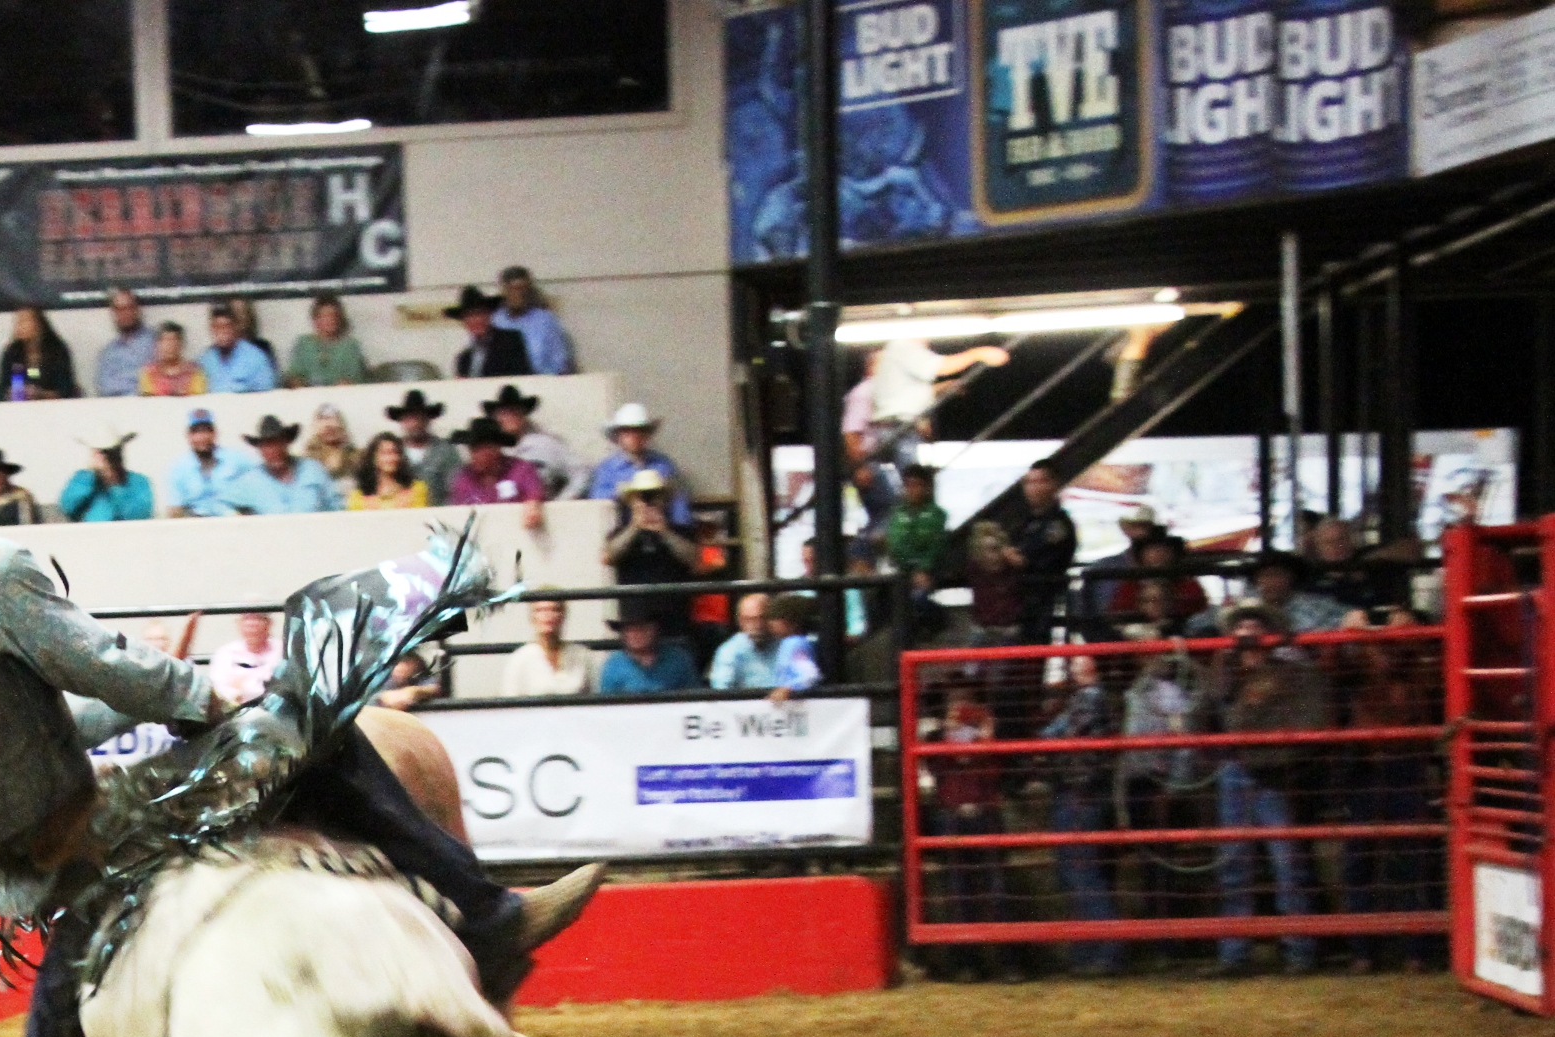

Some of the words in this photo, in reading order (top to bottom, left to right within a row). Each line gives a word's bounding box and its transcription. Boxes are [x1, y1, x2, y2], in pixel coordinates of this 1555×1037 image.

[856, 4, 940, 53] BUD
[1168, 11, 1273, 84] BUD
[1279, 6, 1392, 80] BUD
[841, 42, 955, 99] LIGHT
[326, 172, 370, 225] H
[357, 217, 404, 268] C
[683, 714, 724, 740] Be
[736, 710, 809, 739] Well
